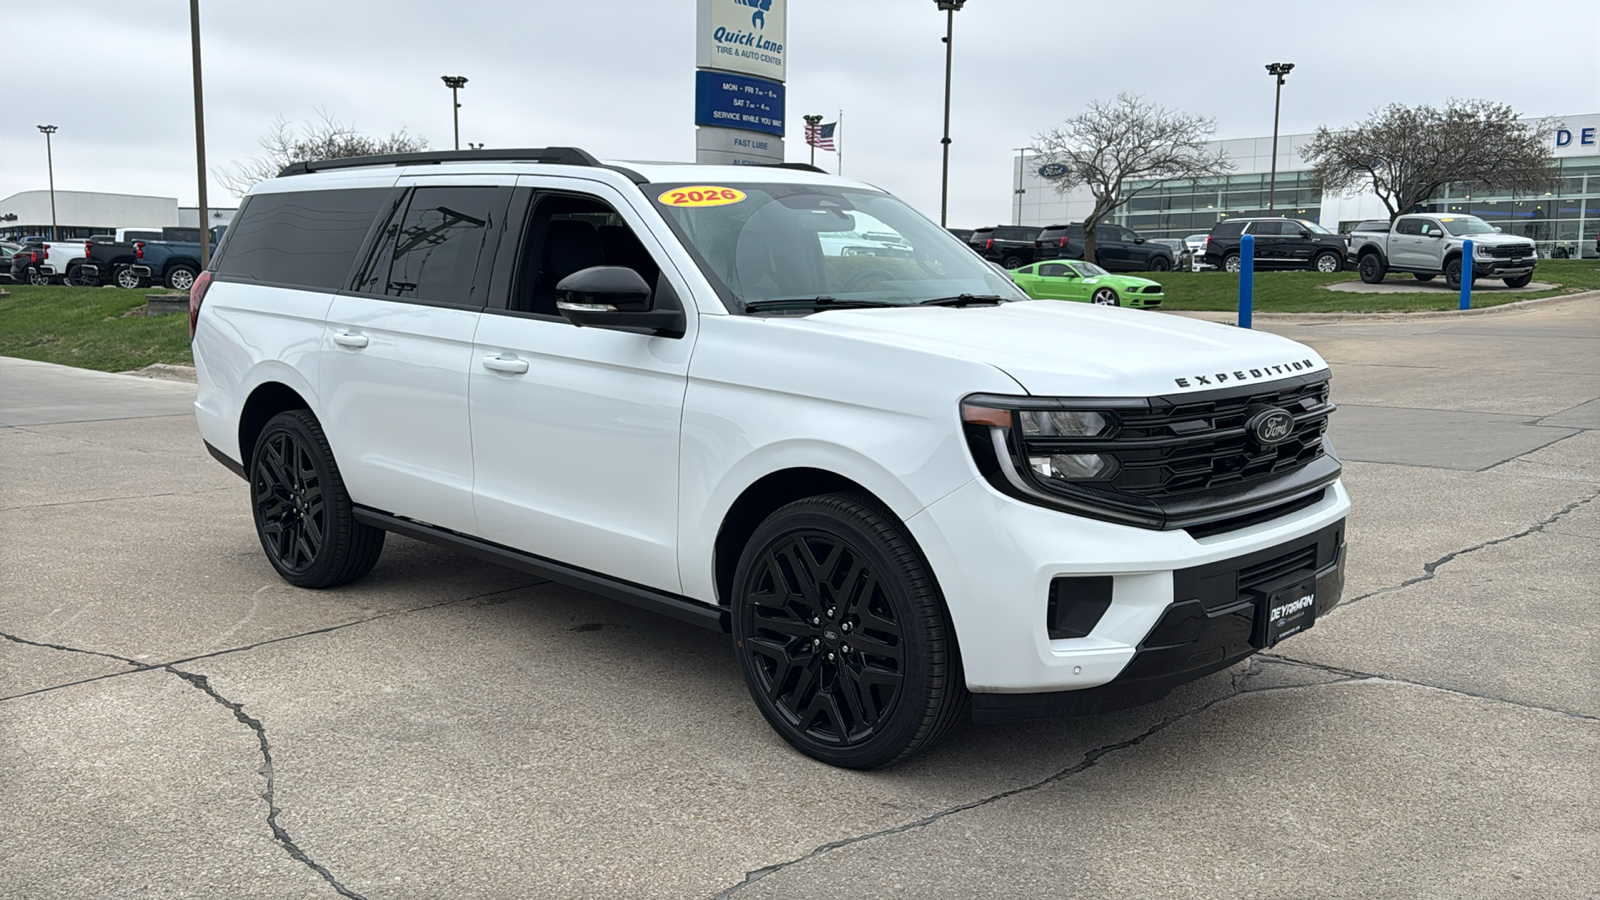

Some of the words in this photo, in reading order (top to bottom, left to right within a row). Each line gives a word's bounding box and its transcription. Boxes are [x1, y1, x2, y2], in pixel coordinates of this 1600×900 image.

[713, 26, 755, 46] Quick
[756, 35, 783, 54] Lane
[716, 45, 733, 55] TIRE
[734, 48, 740, 56] &
[741, 49, 759, 60] AUTO
[760, 54, 782, 66] CENTER
[722, 82, 738, 91] MON
[744, 85, 754, 94] FRI
[733, 98, 744, 106] SAT
[713, 110, 740, 120] SERVICE
[742, 114, 759, 123] WHILE
[761, 117, 771, 125] YOU
[772, 119, 782, 127] WAIT
[734, 138, 751, 147] FAST
[752, 141, 768, 150] LUBE
[671, 189, 737, 204] 2026
[1174, 359, 1314, 388] EXPEDITION
[1264, 416, 1288, 439] Ford
[1270, 594, 1314, 622] DEYARMAN
